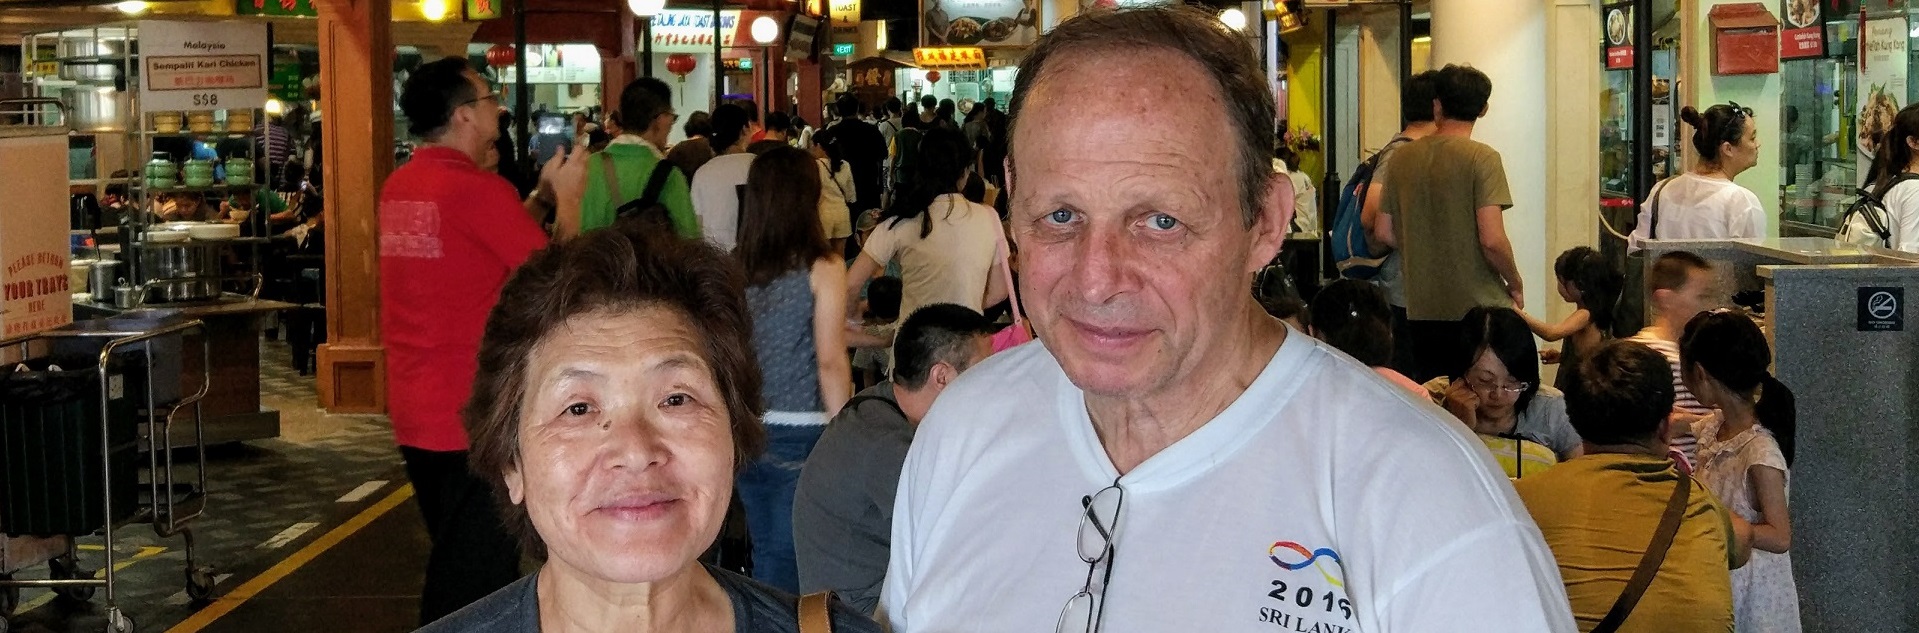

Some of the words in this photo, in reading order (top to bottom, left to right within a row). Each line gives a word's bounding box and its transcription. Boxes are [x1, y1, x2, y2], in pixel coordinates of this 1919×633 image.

[183, 41, 226, 51] Malaysia
[219, 60, 256, 68] Chicken
[193, 93, 218, 106] S$8
[8, 253, 35, 278] PLEASE
[4, 280, 34, 301] YOUR
[36, 273, 69, 296] TRAYS
[28, 299, 45, 313] HERE
[1259, 606, 1291, 629] SRI
